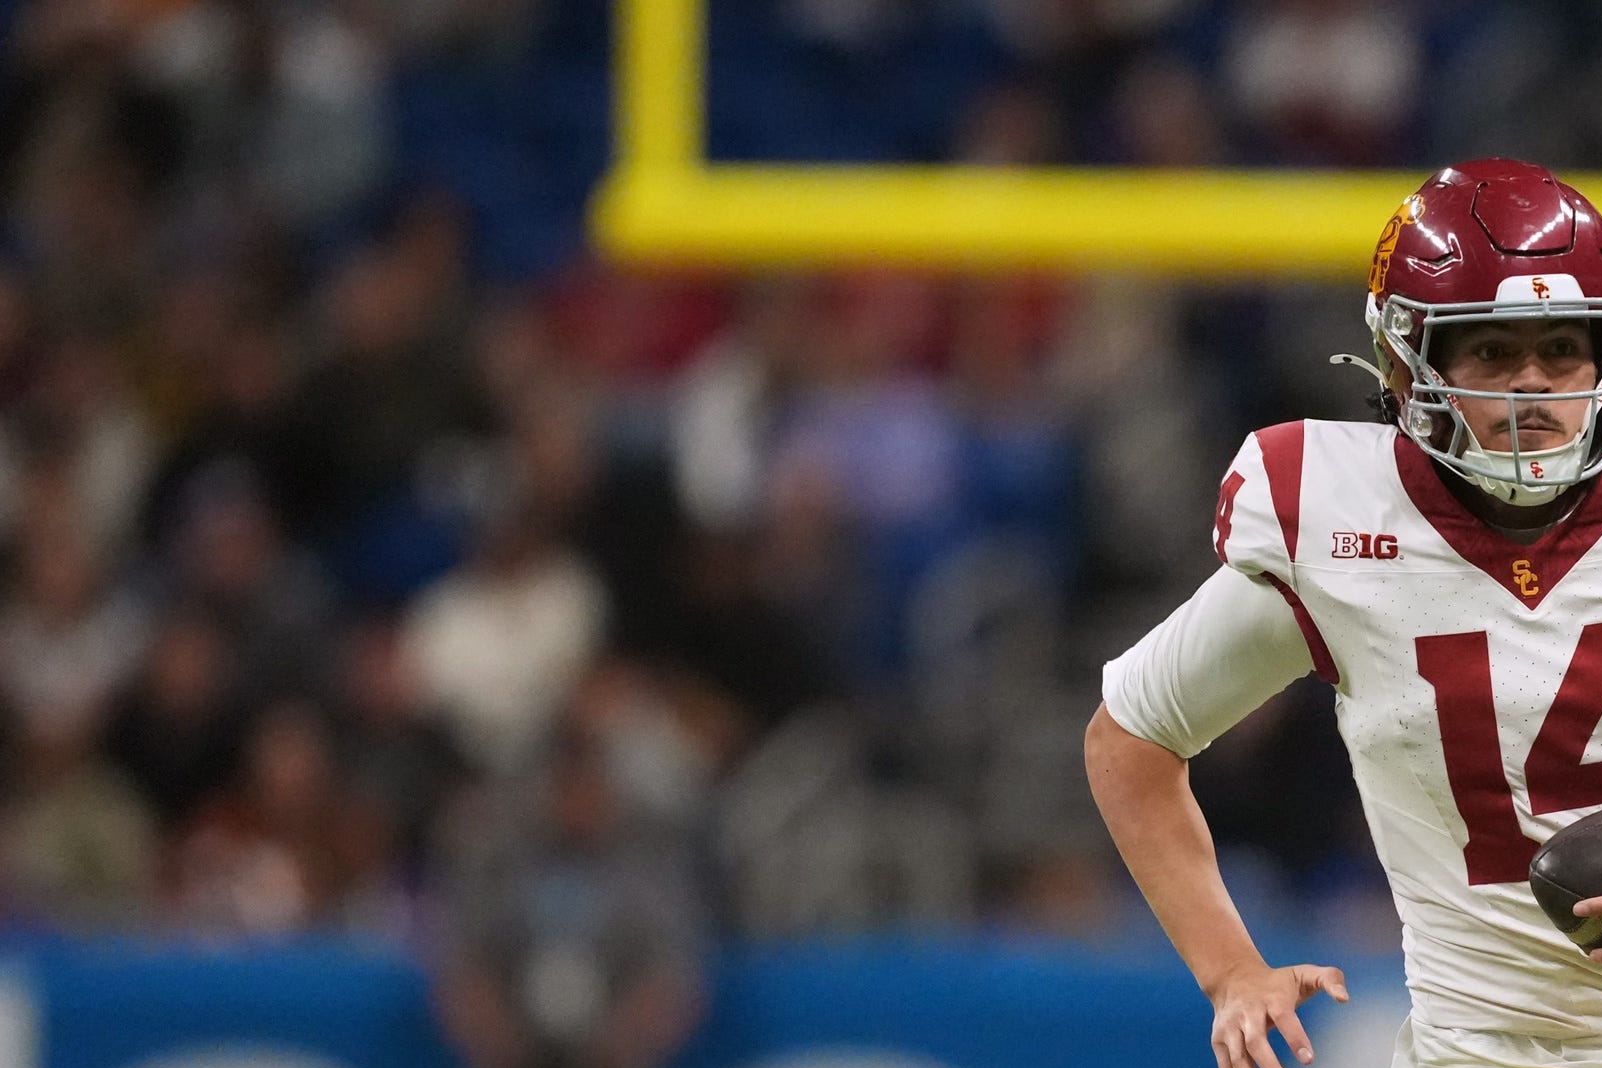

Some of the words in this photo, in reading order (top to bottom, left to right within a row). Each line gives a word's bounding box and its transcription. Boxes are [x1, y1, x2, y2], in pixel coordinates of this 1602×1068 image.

[1532, 277, 1550, 299] SC
[1530, 461, 1544, 479] SC
[1512, 559, 1539, 596] SC
